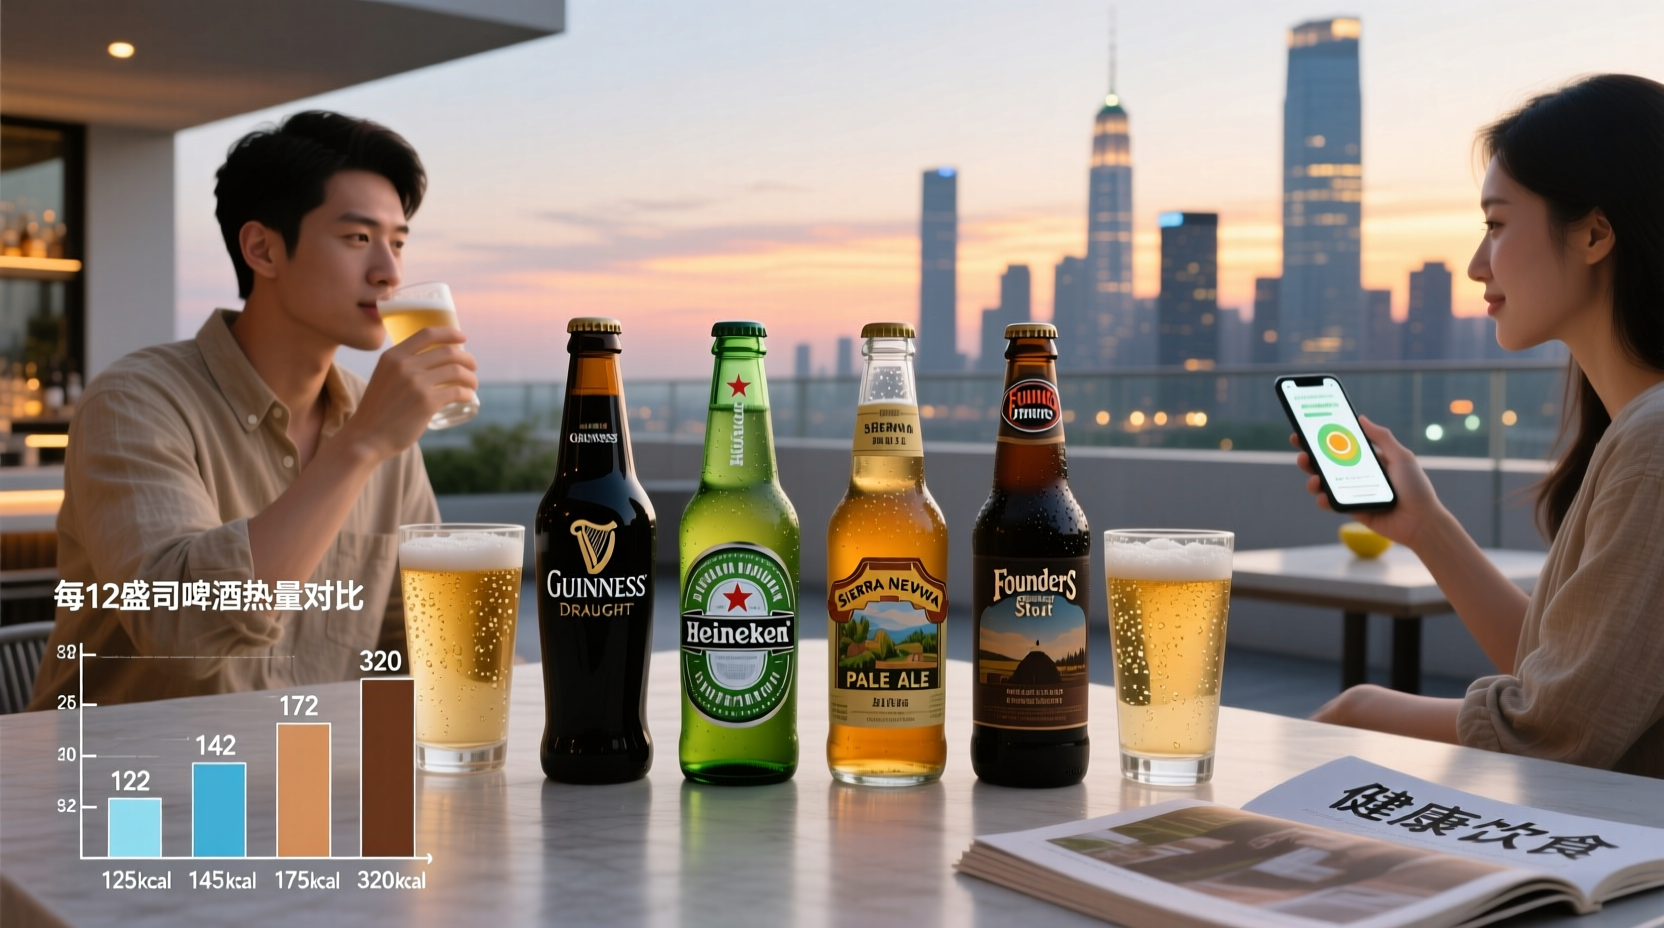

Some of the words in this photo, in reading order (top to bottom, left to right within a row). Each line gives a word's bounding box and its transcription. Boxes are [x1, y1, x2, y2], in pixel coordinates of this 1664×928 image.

[547, 570, 646, 598] GUINNESS
[838, 579, 884, 608] SIERRA
[993, 568, 1077, 602] Founders
[560, 602, 634, 617] DRAUGHT
[687, 620, 790, 644] Heineken
[847, 671, 890, 688] PALE
[898, 671, 930, 688] ALE
[1329, 783, 1620, 860] 健康饮食
